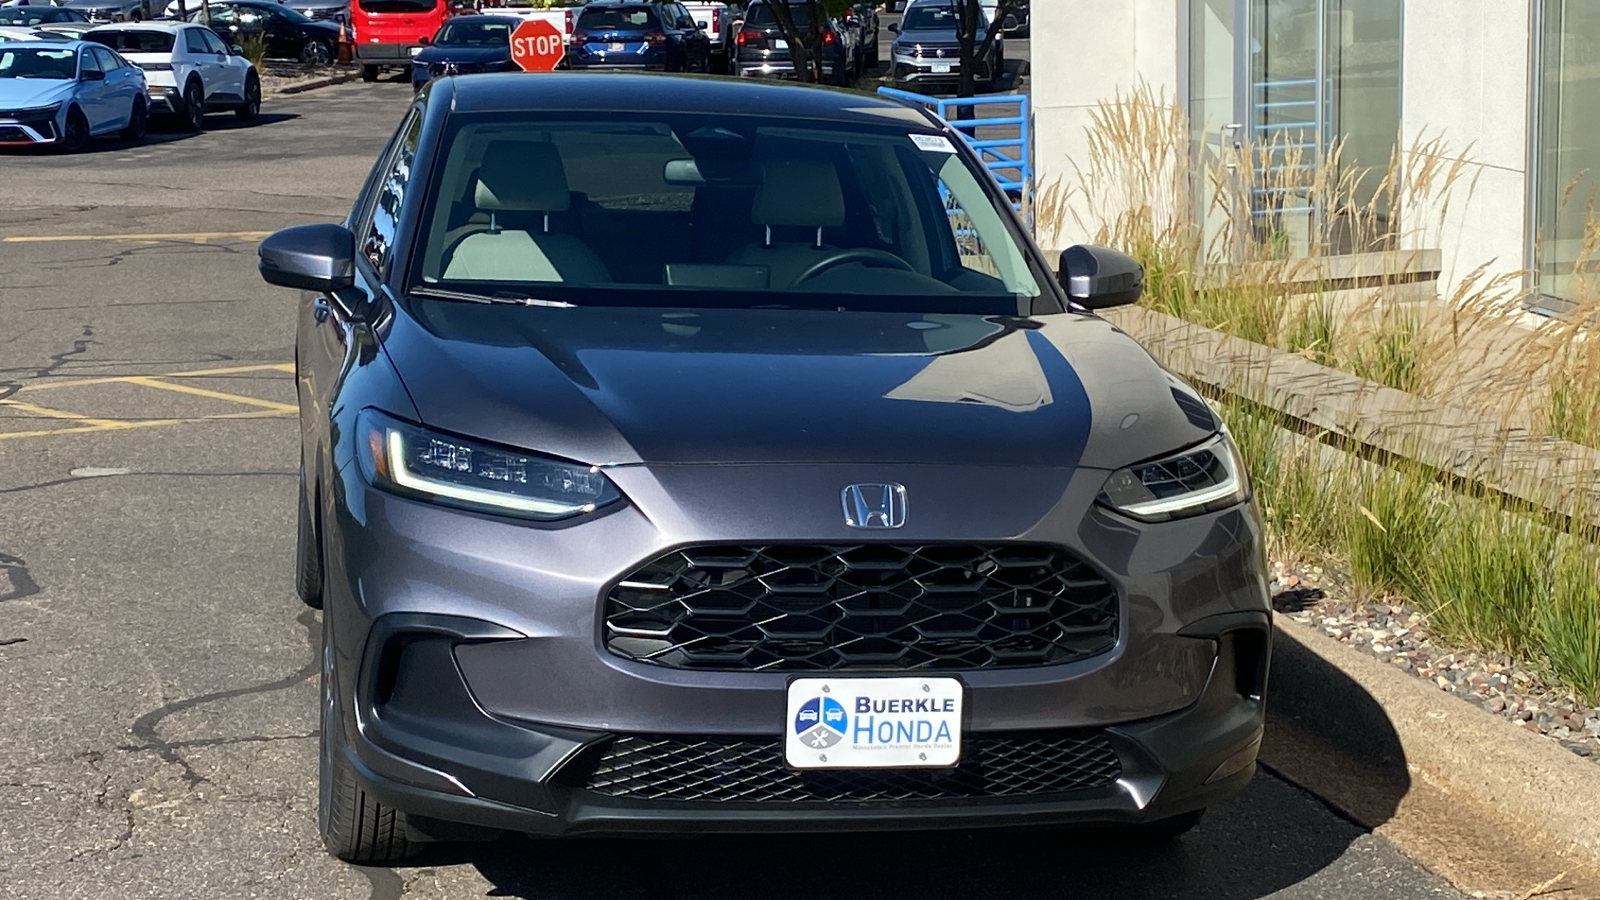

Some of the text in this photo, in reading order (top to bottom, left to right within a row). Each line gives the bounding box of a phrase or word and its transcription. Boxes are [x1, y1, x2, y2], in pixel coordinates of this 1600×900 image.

[514, 34, 560, 57] STOP
[855, 696, 955, 714] BUERKLE
[853, 715, 953, 744] HONDA
